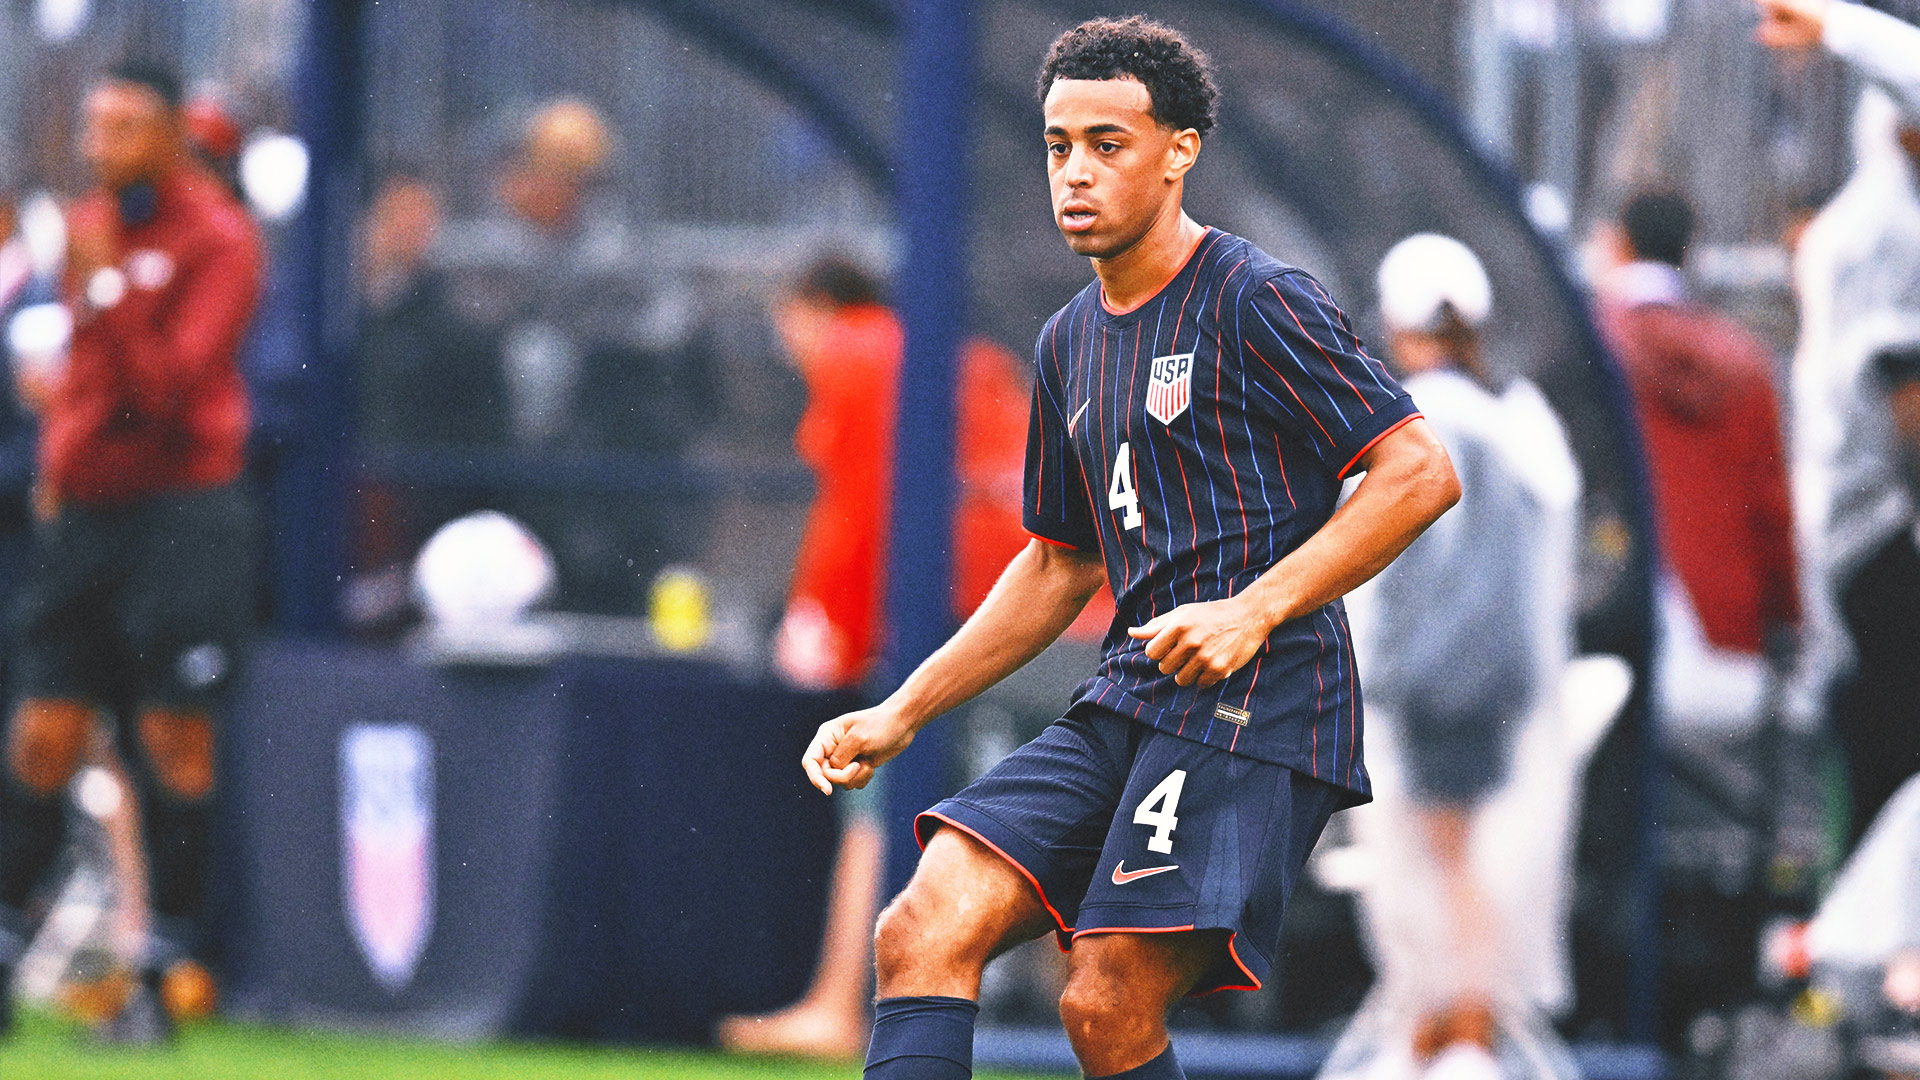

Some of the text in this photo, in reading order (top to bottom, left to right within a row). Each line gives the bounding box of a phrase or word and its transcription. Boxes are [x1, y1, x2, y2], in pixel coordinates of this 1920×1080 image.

[1153, 358, 1189, 384] USA
[1108, 441, 1142, 530] 4
[1132, 769, 1187, 855] 4
